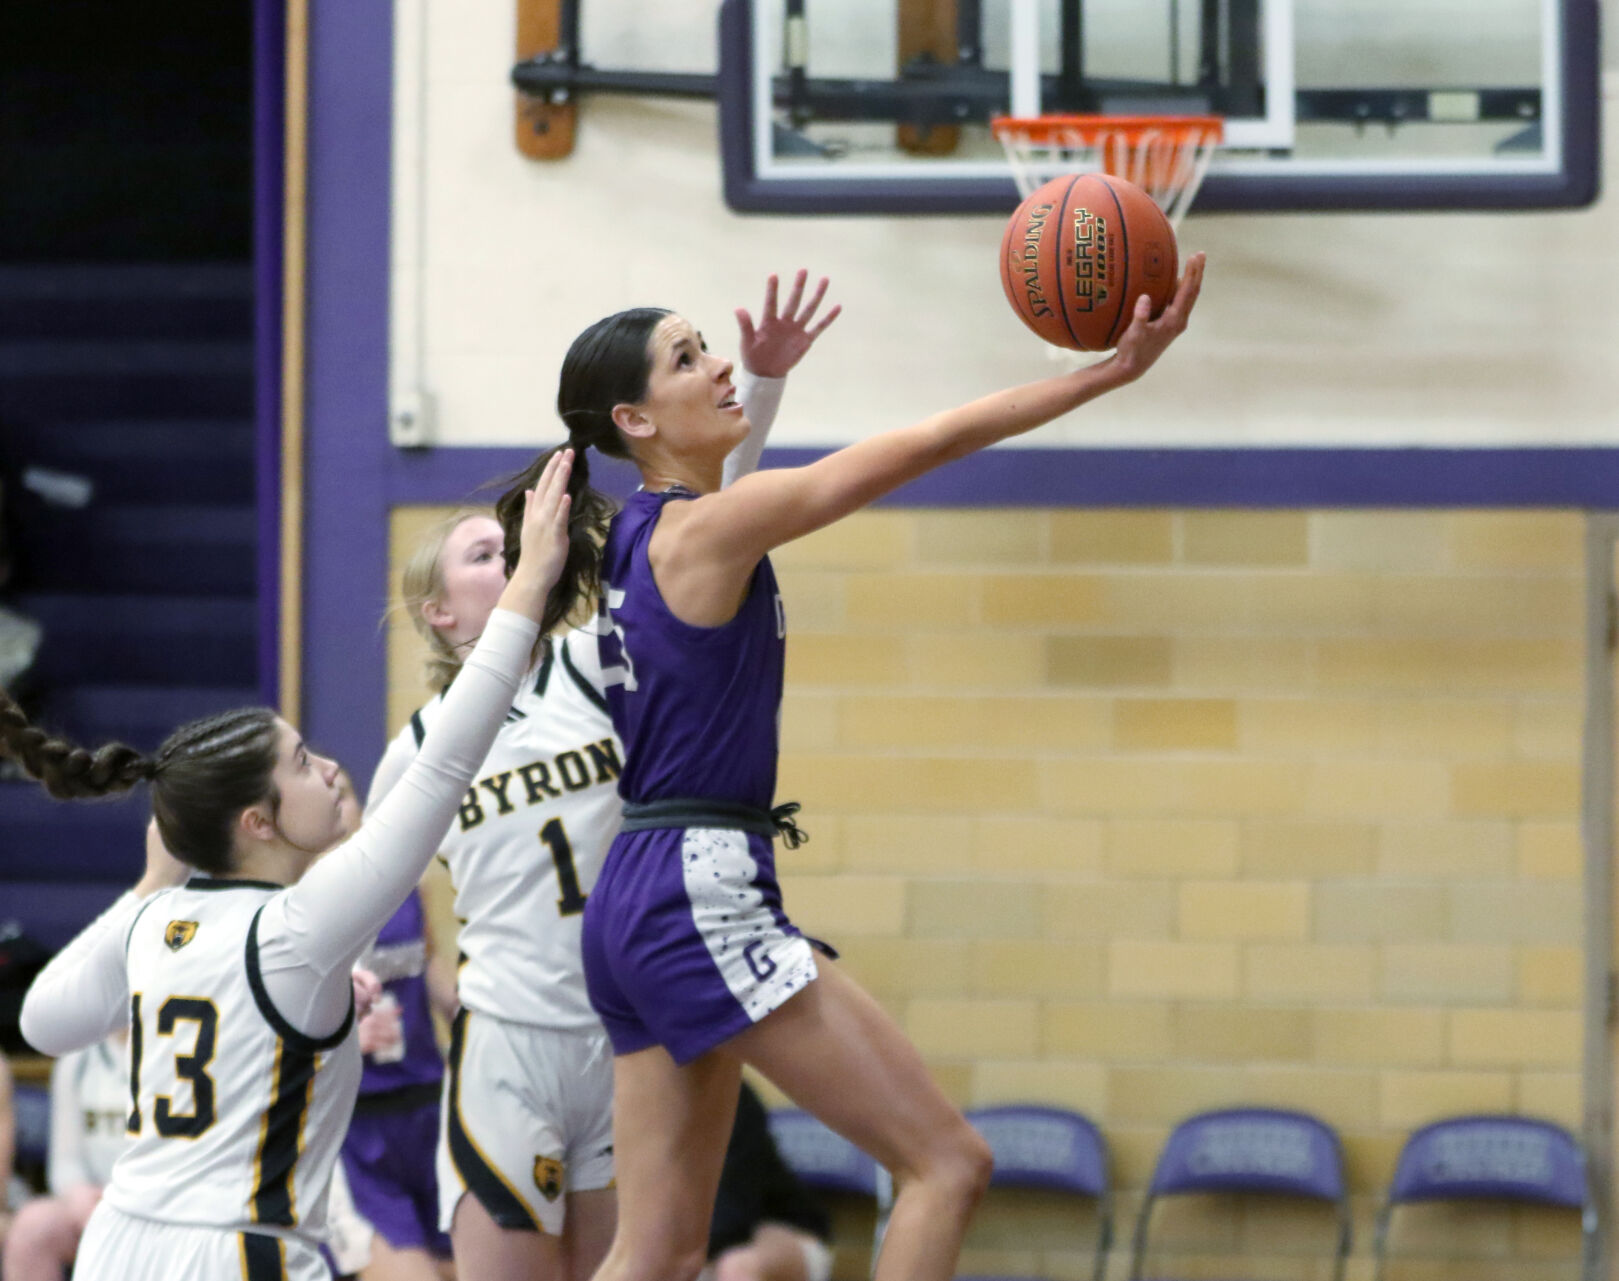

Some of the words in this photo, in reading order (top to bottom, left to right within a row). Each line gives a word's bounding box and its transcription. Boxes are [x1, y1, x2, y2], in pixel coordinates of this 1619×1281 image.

[1024, 203, 1054, 318] SPALDING
[1074, 207, 1094, 313] LEGACY
[458, 738, 623, 832] BYRON
[539, 816, 589, 917] 1
[743, 940, 777, 983] G
